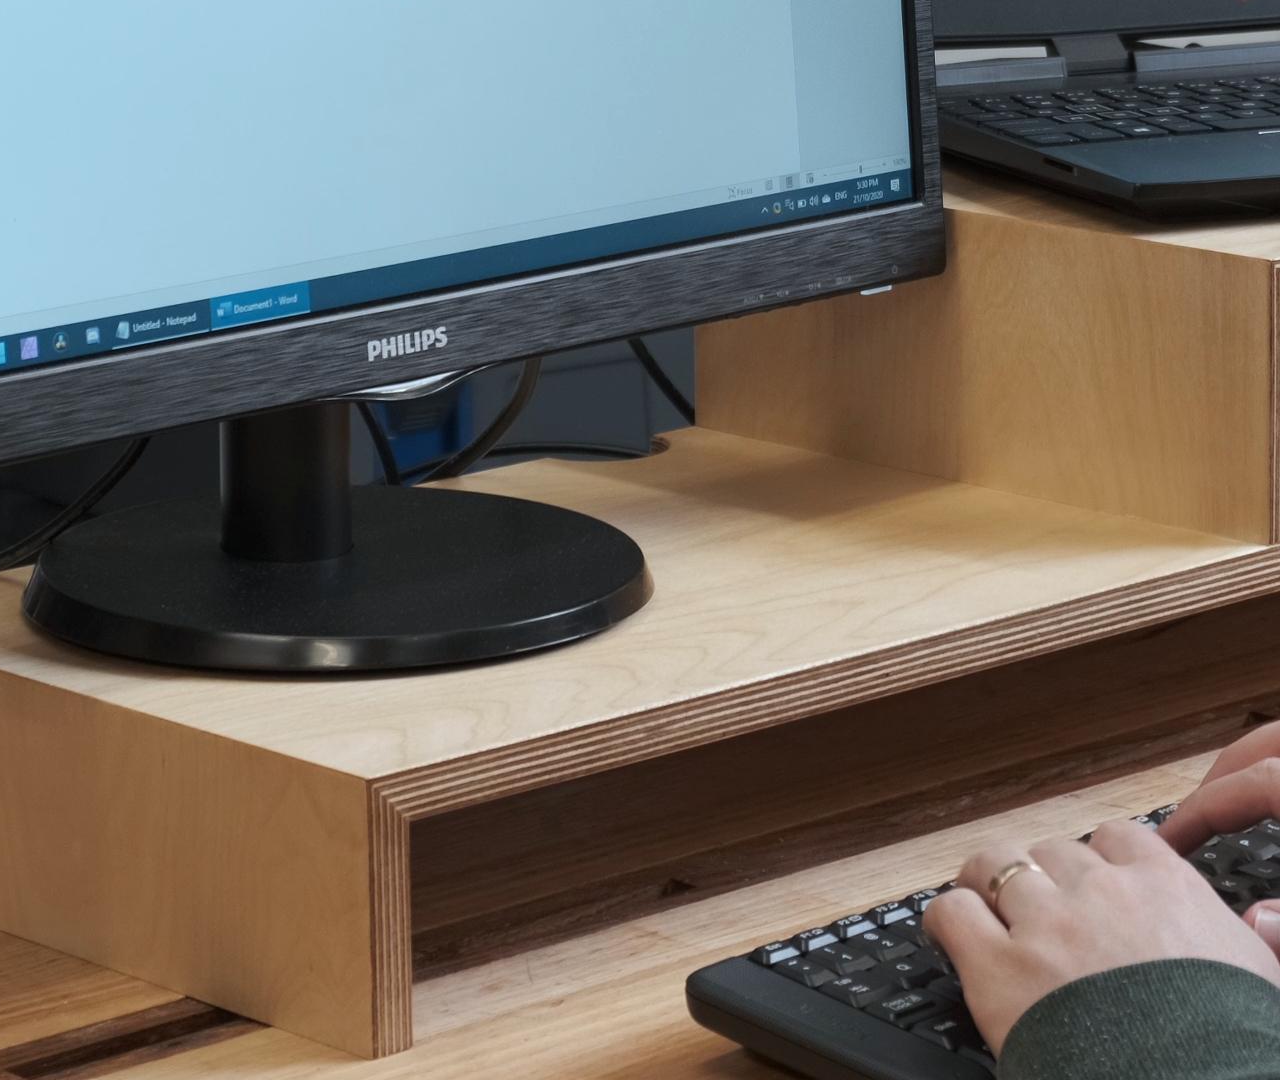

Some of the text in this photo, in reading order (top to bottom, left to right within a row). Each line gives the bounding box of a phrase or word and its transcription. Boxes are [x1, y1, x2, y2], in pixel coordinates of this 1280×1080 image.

[834, 190, 848, 201] ENG
[233, 300, 273, 314] Document1
[279, 294, 298, 306] Word
[133, 319, 161, 333] Untitled
[166, 312, 197, 327] Notepad
[367, 325, 448, 362] PHILIPS
